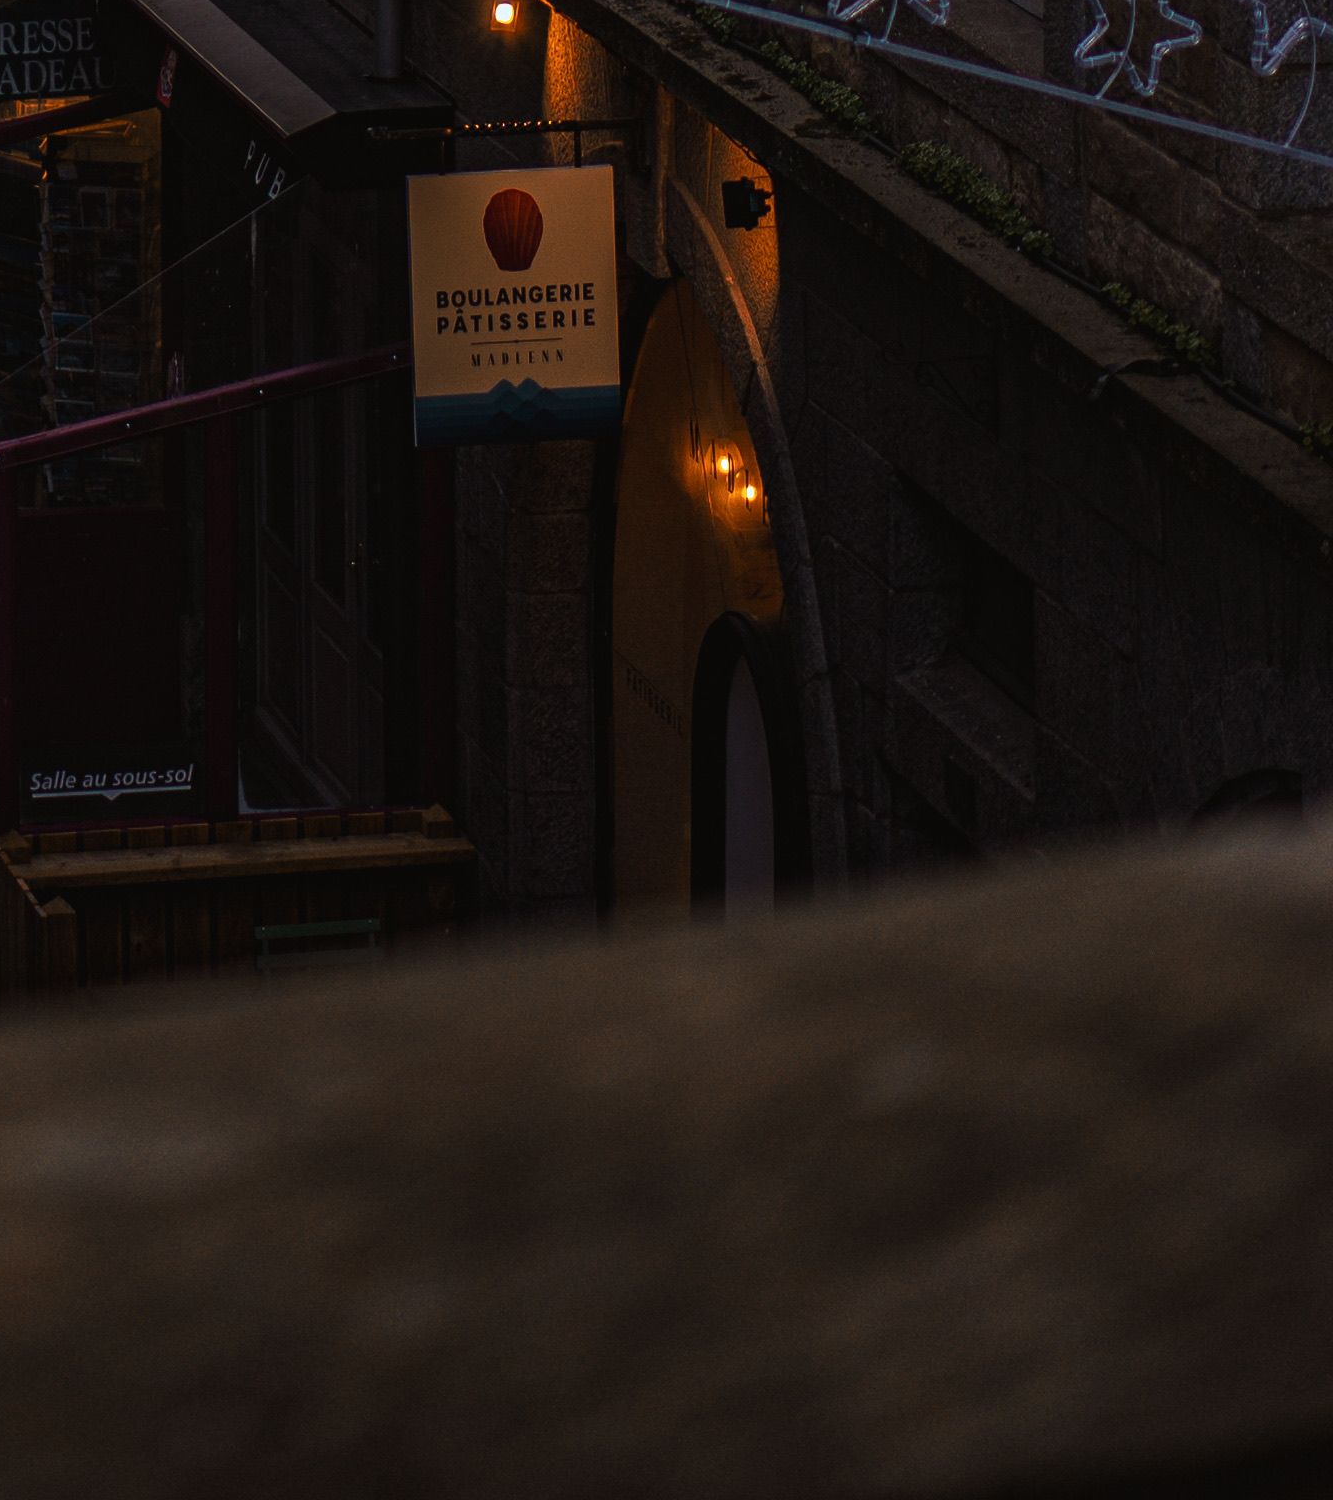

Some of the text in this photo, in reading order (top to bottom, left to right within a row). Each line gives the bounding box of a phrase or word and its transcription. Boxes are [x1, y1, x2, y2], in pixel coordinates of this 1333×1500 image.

[244, 139, 286, 200] PUB
[436, 282, 595, 309] BOULANGERIE
[436, 307, 596, 335] PÂTISSERIE
[471, 348, 565, 368] MADLENN
[30, 763, 195, 791] Salle au sous-sol
